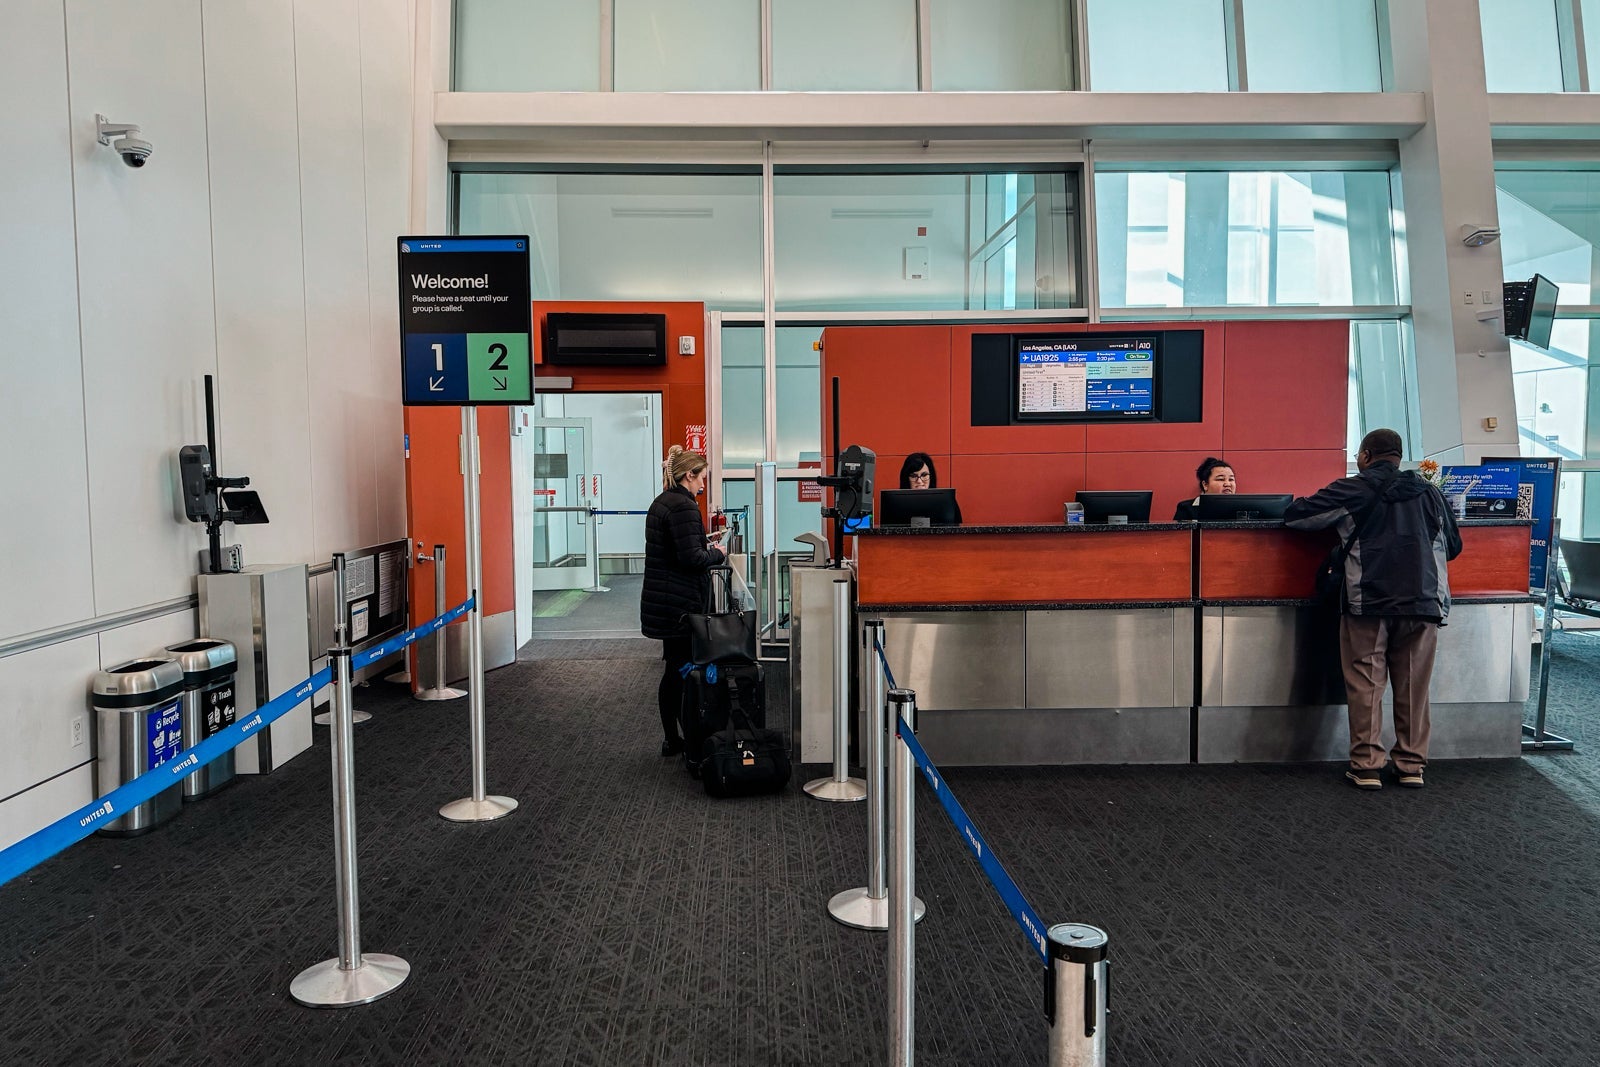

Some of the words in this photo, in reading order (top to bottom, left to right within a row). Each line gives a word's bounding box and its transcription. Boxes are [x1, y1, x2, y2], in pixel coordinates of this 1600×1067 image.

[411, 273, 489, 289] Welcome!
[412, 294, 436, 302] Please
[436, 294, 454, 302] have
[476, 294, 491, 302] until
[492, 296, 508, 304] your
[412, 305, 434, 314] group
[434, 304, 440, 312] is
[441, 304, 465, 312] called.
[431, 343, 444, 371] 1
[488, 343, 509, 371] 2
[219, 688, 231, 700] Trash
[163, 711, 179, 726] Recycle
[241, 719, 258, 732] UNITED
[171, 758, 192, 774] UNITED
[80, 807, 105, 827] UNITED
[1021, 911, 1040, 944] UNITED
